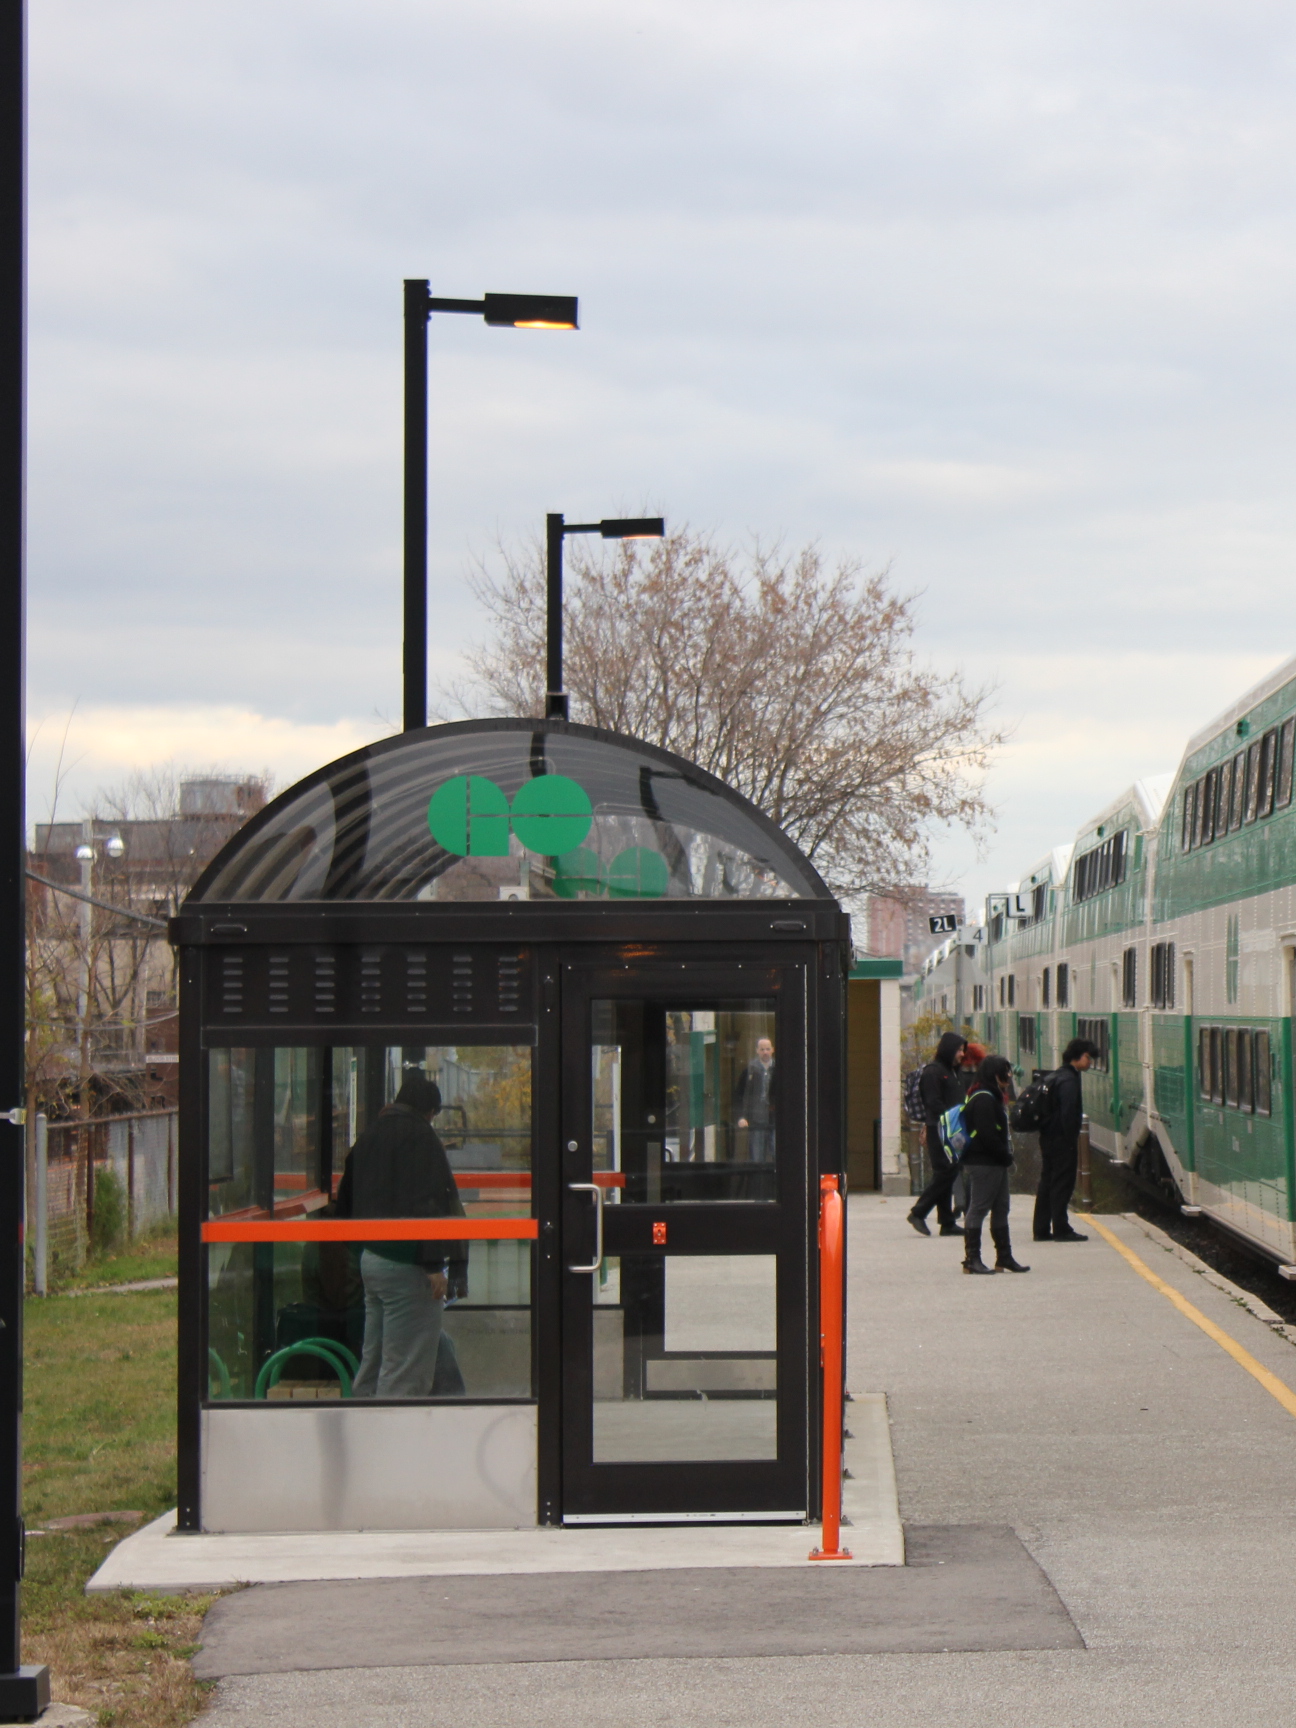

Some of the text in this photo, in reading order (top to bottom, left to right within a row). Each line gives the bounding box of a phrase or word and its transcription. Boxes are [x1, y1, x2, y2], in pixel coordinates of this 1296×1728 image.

[427, 774, 593, 857] GO
[933, 917, 953, 933] 2L
[973, 929, 983, 943] 4
